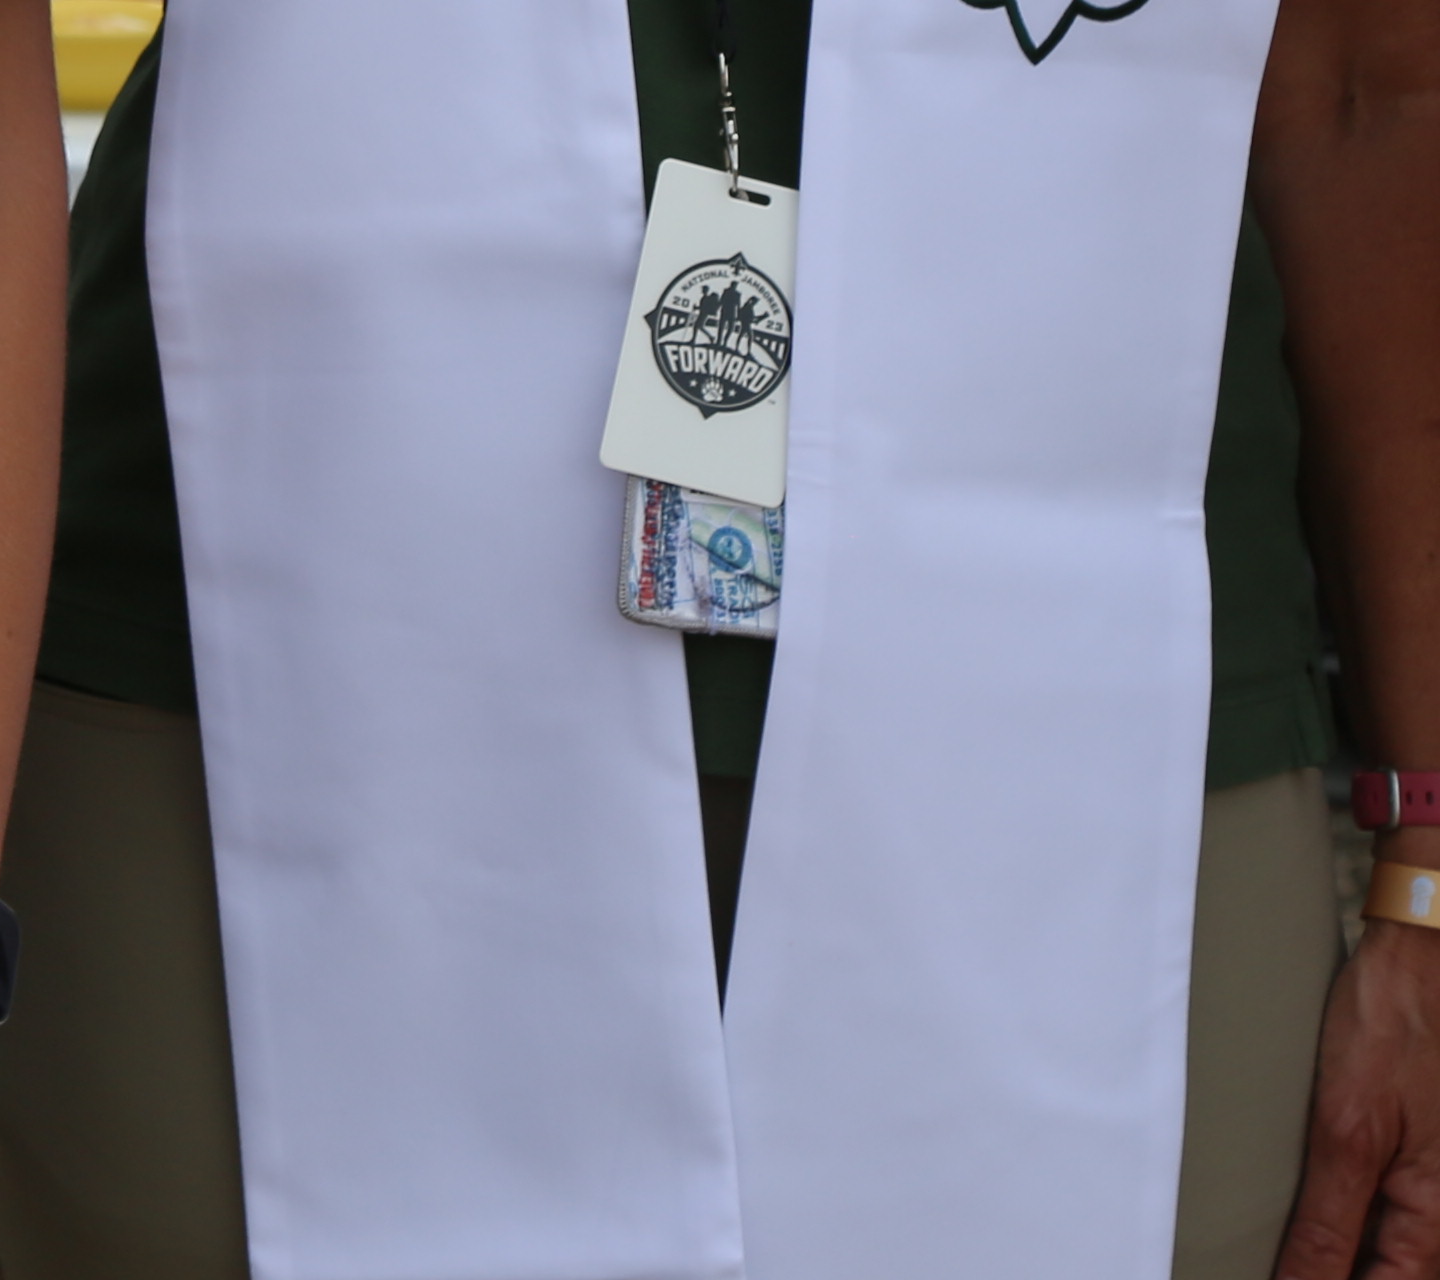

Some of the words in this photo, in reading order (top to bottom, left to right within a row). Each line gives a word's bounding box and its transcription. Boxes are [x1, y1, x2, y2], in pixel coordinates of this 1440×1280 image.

[672, 295, 690, 309] 20
[681, 269, 731, 293] NATIONAL
[741, 274, 782, 316] JAMBOREE
[766, 318, 784, 333] 23
[664, 342, 774, 393] FORWARD
